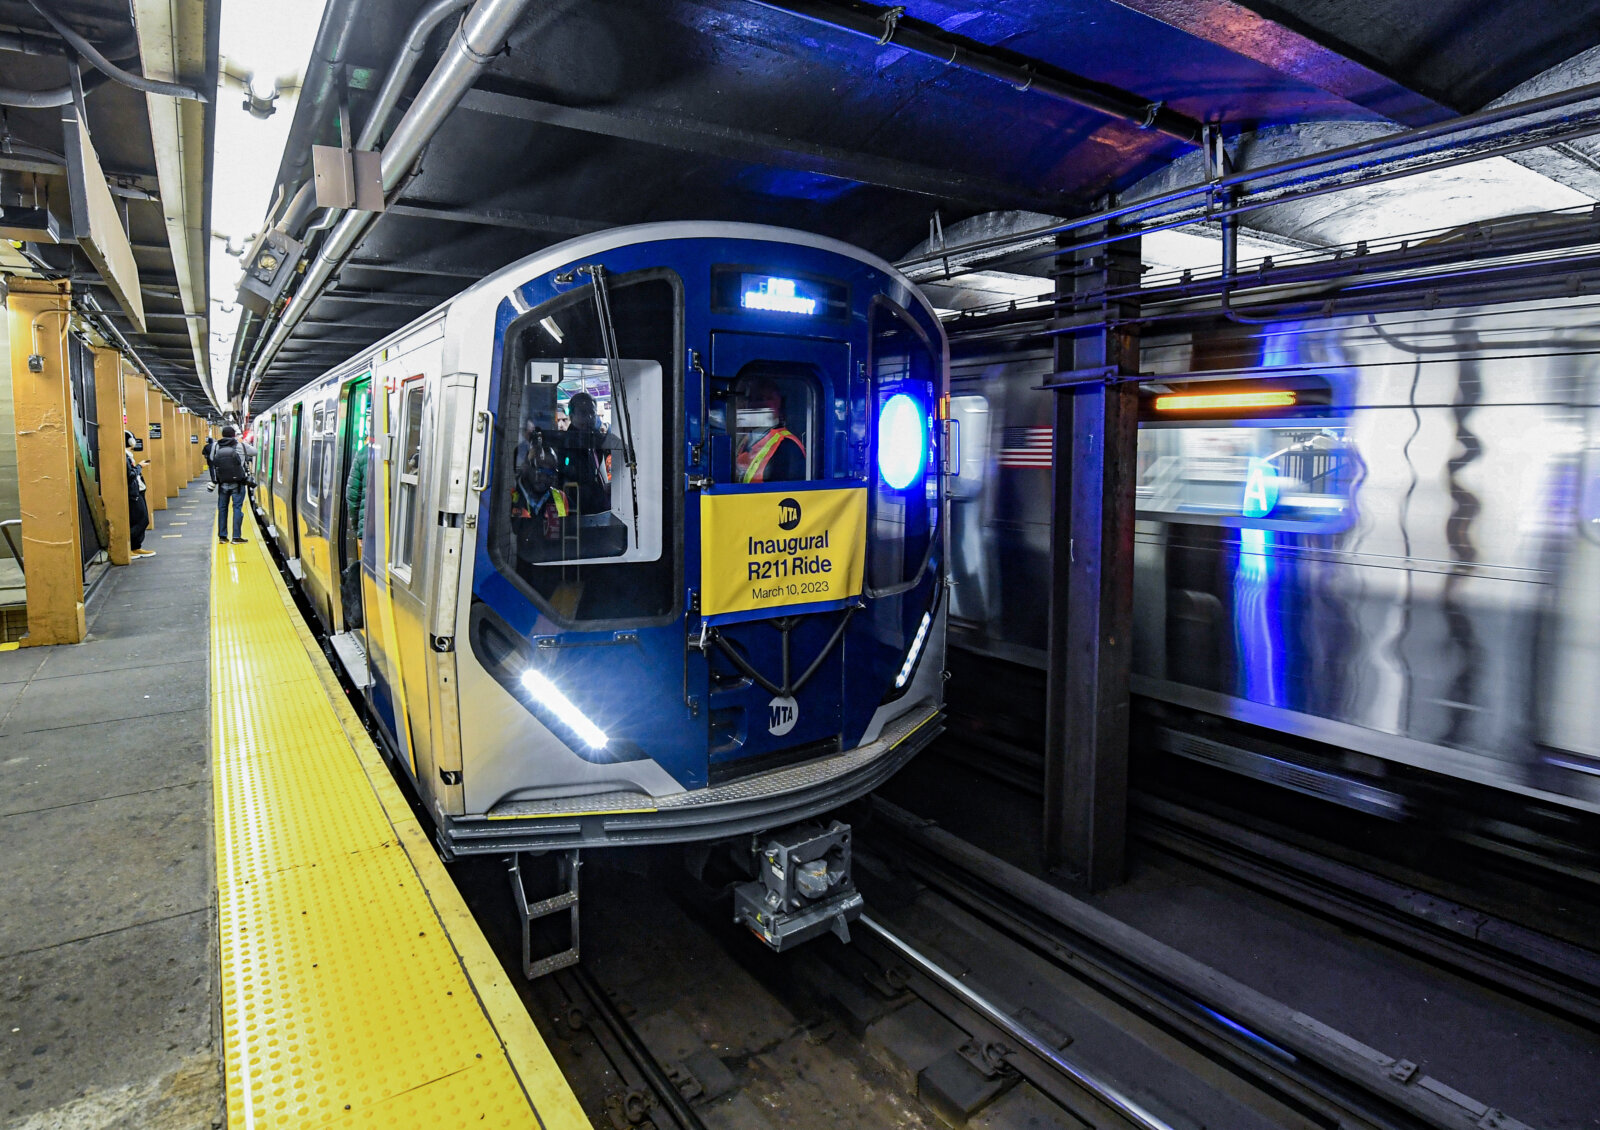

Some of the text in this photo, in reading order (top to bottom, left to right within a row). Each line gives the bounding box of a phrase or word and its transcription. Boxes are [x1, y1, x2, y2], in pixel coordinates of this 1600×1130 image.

[1243, 468, 1268, 511] A
[778, 505, 798, 525] MTA
[748, 530, 829, 556] Inaugural
[748, 555, 832, 581] R211 Ride
[752, 581, 829, 600] March 10, 2023
[768, 704, 794, 730] MTA
